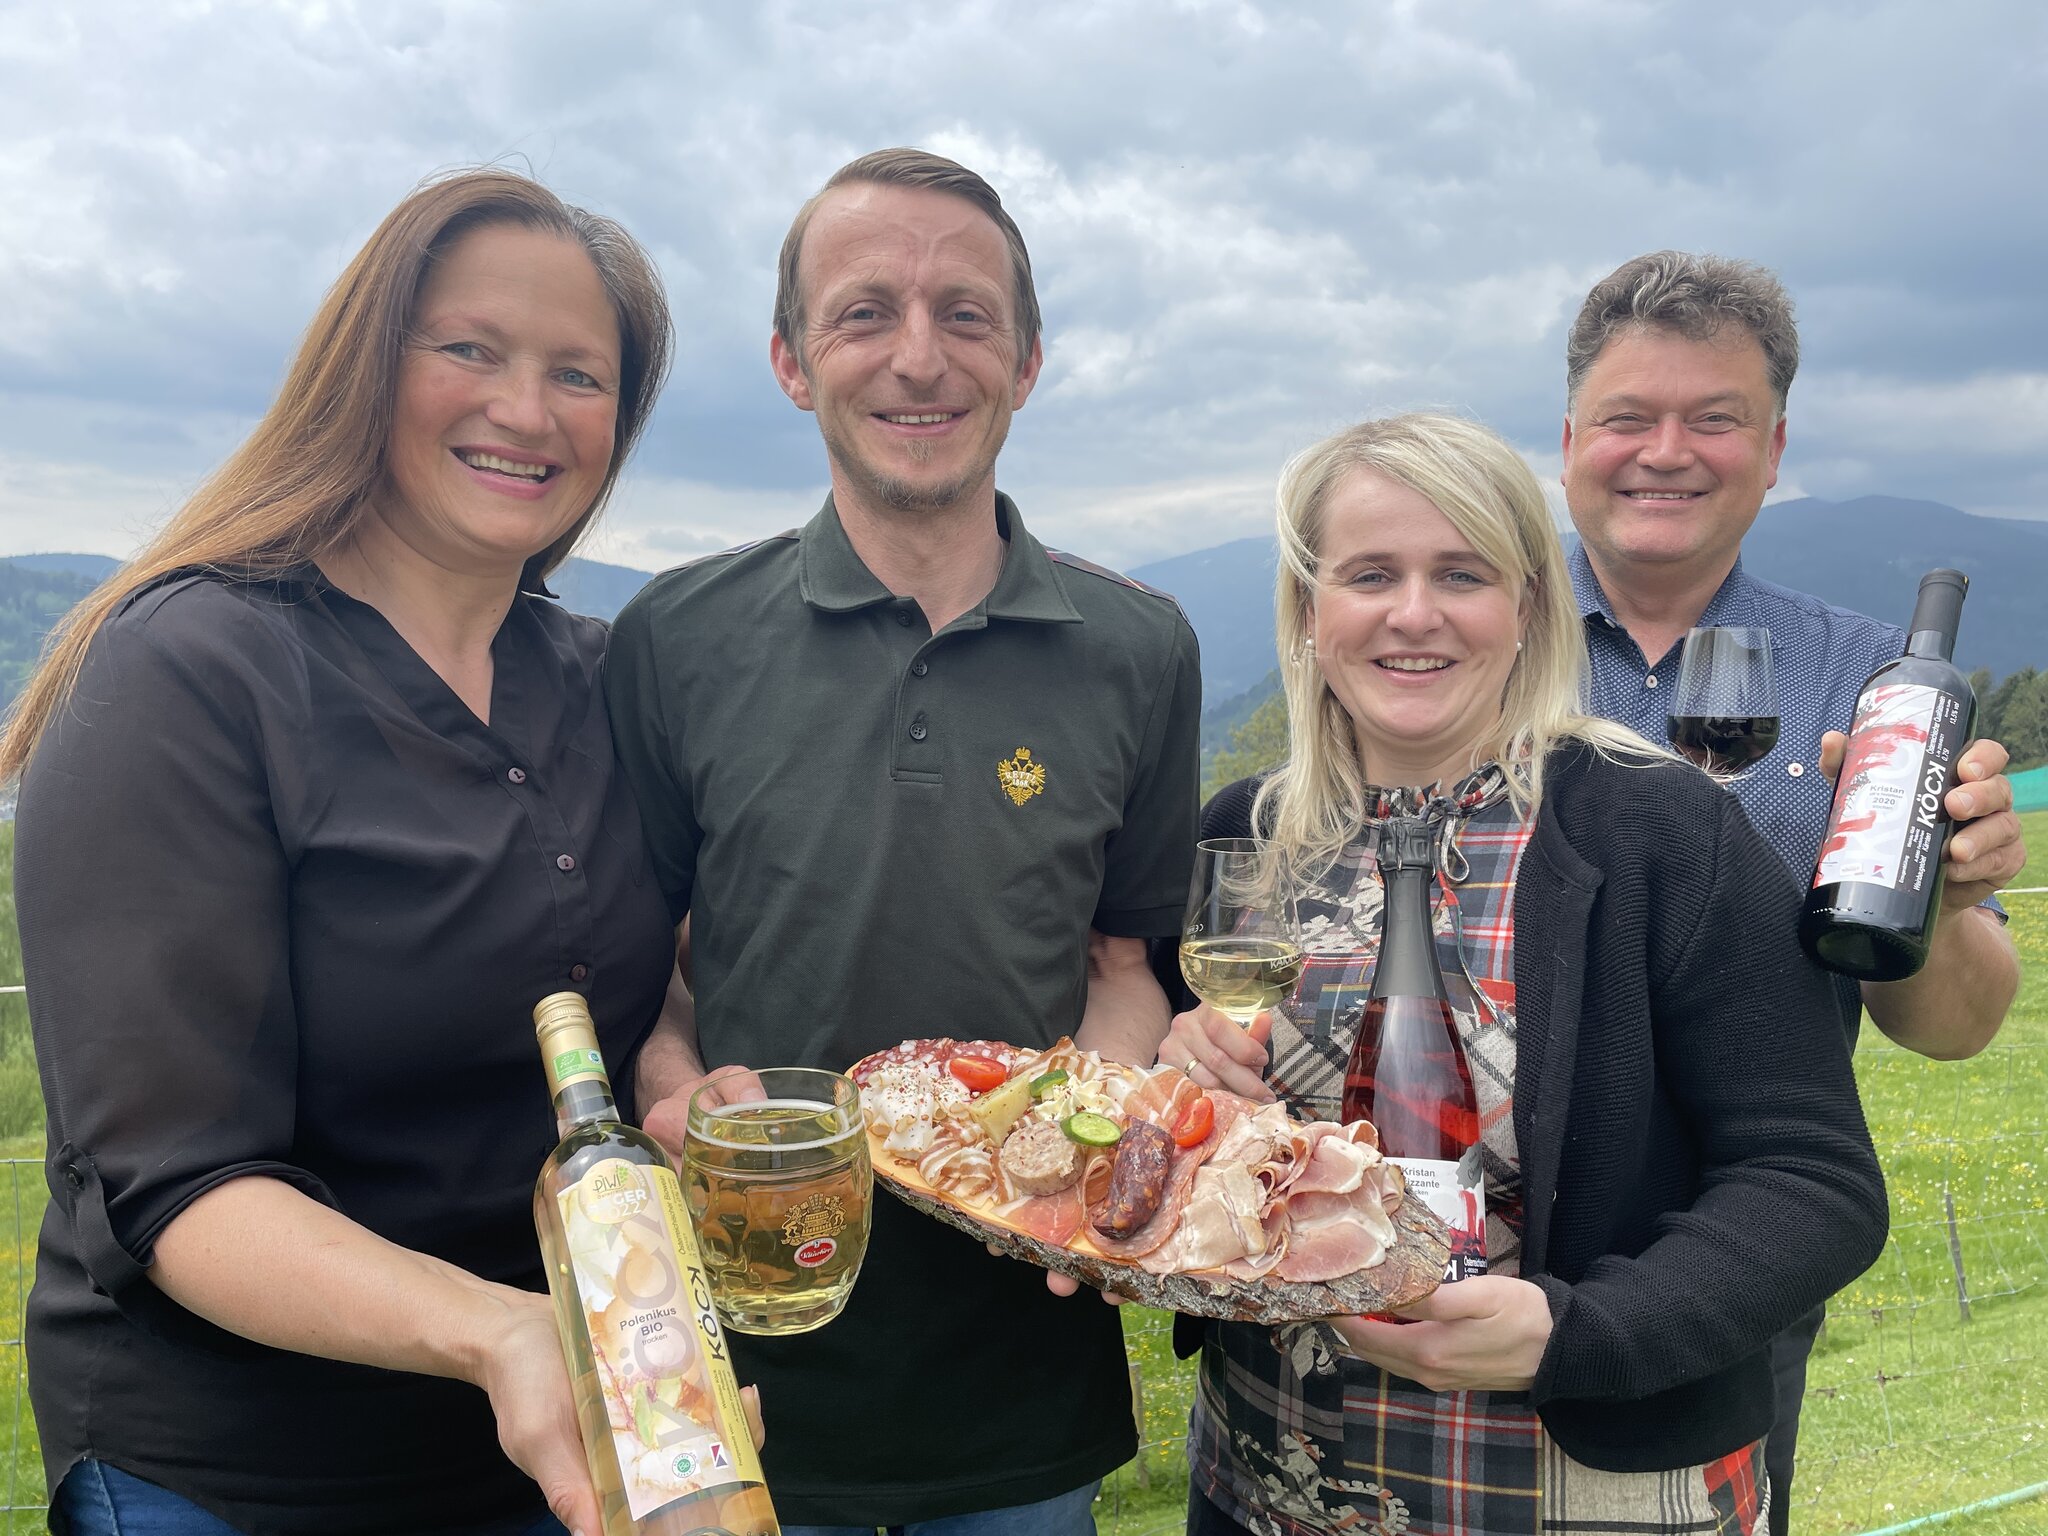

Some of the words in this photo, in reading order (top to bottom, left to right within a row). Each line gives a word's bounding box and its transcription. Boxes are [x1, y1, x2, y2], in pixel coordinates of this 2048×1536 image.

[1870, 785, 1905, 795] Kristan
[1917, 761, 1947, 829] KÖCK
[1872, 797, 1896, 806] 2020
[1402, 1167, 1435, 1177] Kristan
[1406, 1178, 1440, 1189] izzante
[619, 1306, 677, 1331] Polenikus
[686, 1265, 727, 1362] KÖCK
[641, 1321, 663, 1338] BIO
[641, 1333, 668, 1346] trocken
